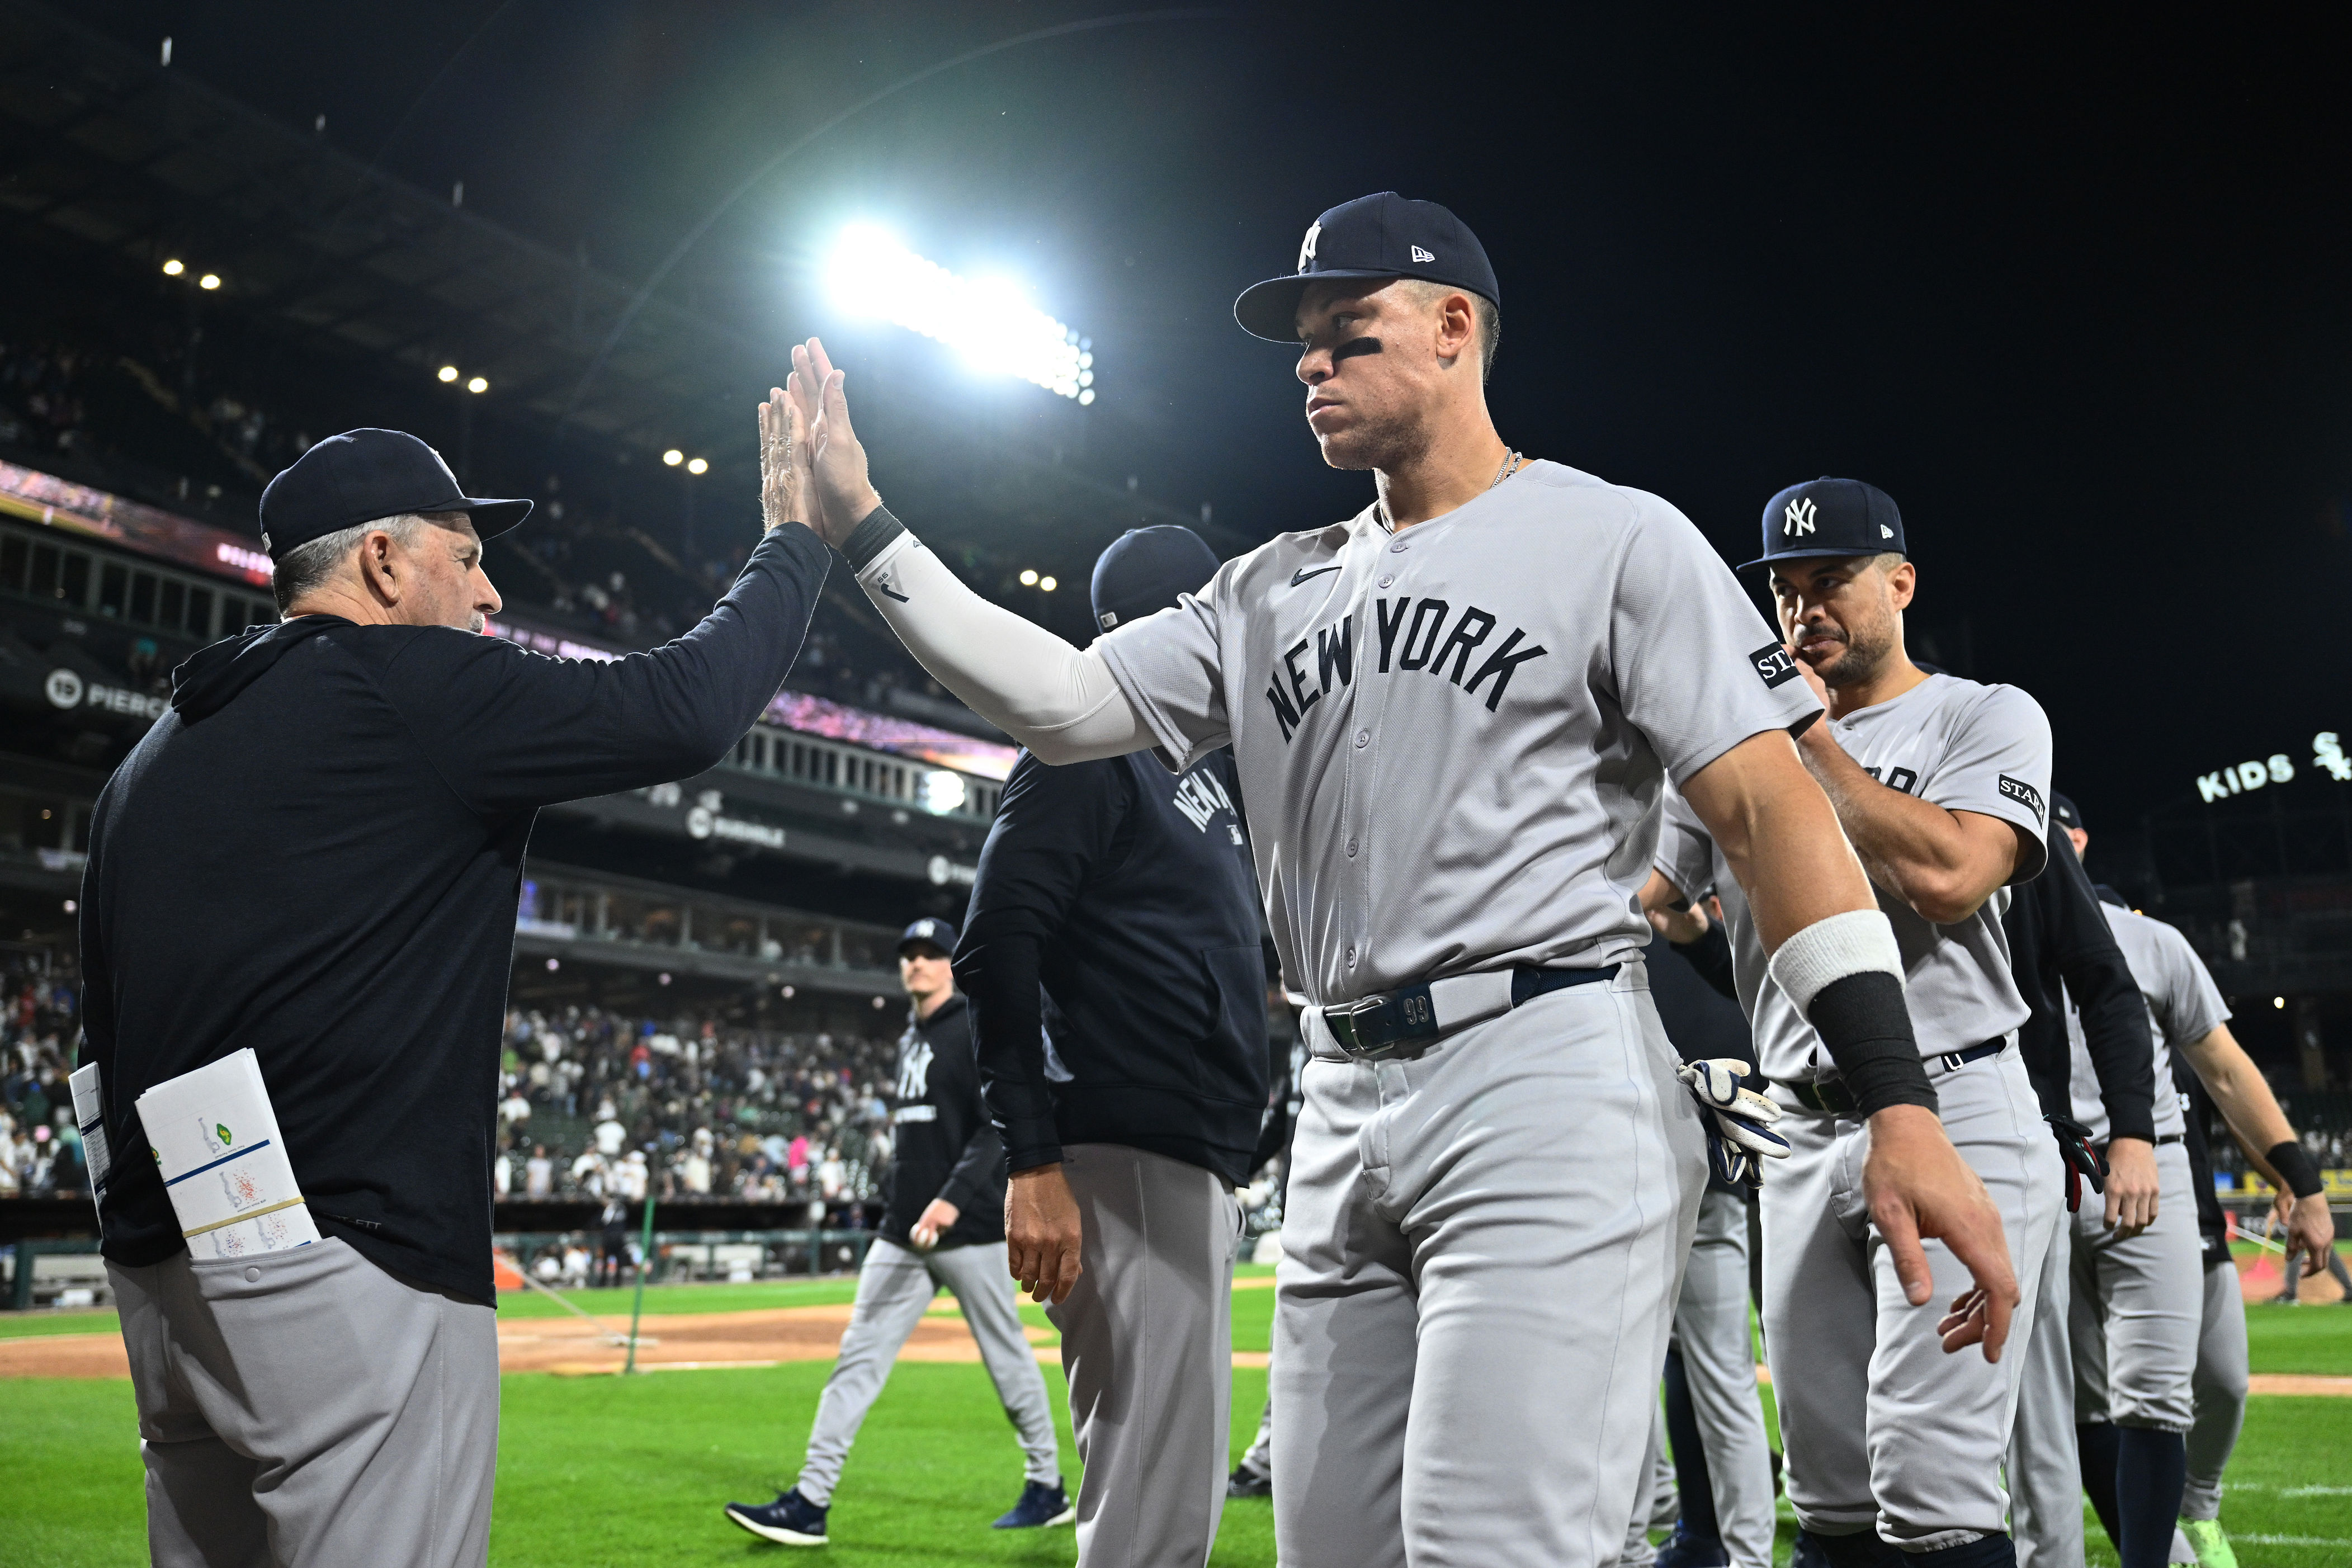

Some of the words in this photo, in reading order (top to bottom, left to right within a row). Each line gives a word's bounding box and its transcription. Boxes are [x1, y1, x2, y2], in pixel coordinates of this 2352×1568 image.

[1783, 497, 1817, 537] NY
[1266, 614, 1353, 745] NEW
[1376, 596, 1548, 713] YORK
[2000, 780, 2043, 823] STARR
[2196, 753, 2295, 804] KIDS
[1173, 772, 1221, 833] NEW
[1403, 995, 1429, 1026] 99
